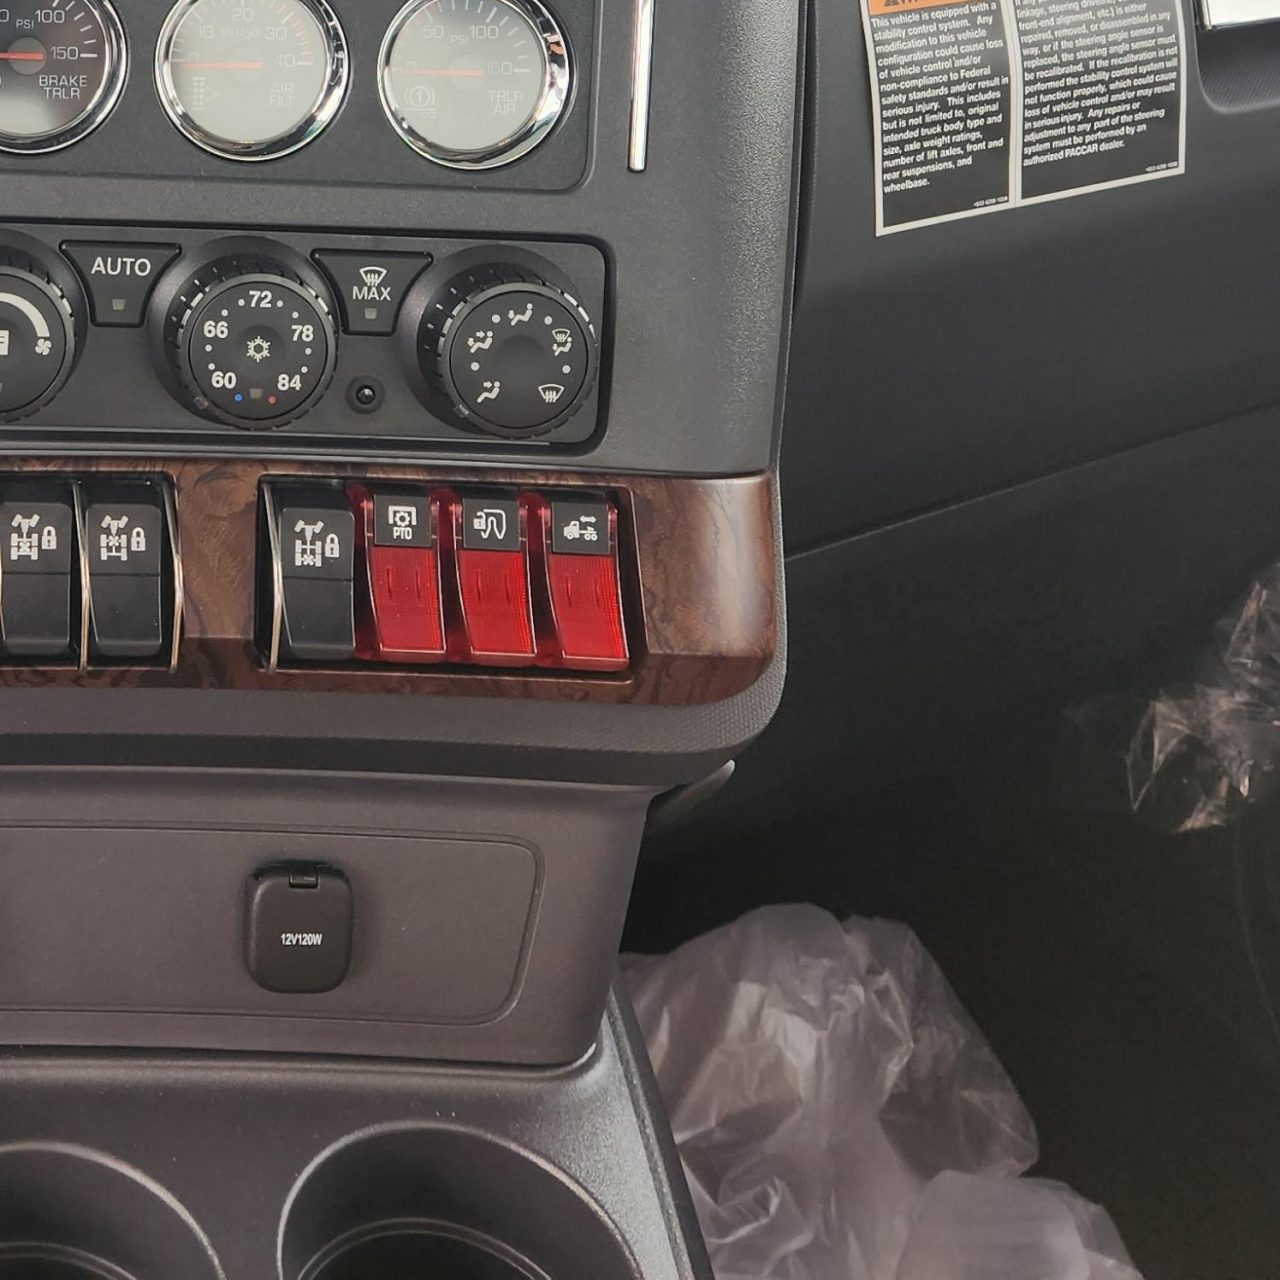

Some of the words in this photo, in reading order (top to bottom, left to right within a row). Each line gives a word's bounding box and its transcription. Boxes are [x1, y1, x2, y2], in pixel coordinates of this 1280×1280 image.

[35, 10, 65, 23] 100
[232, 8, 254, 21] 20
[16, 19, 34, 30] PSI
[470, 25, 499, 39] 100
[874, 28, 905, 41] stability
[908, 23, 936, 35] control
[939, 19, 971, 32] system.
[977, 16, 992, 25] Any
[199, 26, 213, 39] 10
[265, 27, 287, 40] 30
[450, 35, 469, 45] PSI
[876, 38, 927, 53] modification
[929, 36, 937, 45] to
[940, 34, 955, 43] this
[958, 29, 986, 40] vehicle
[50, 47, 79, 60] 150
[878, 50, 933, 66] configuration
[935, 46, 958, 57] could
[960, 42, 984, 52] cause
[986, 39, 1003, 49] loss
[273, 54, 296, 67] 40
[880, 70, 888, 79] of
[891, 65, 920, 77] vehicle
[923, 59, 952, 72] control
[39, 75, 87, 87] BRAKE
[881, 72, 948, 92] non-compliance
[950, 71, 958, 80] to
[960, 66, 991, 79] Federal
[44, 88, 80, 99] TRLR
[271, 83, 293, 93] AIR
[882, 92, 906, 105] safety
[909, 86, 948, 100] standards
[978, 78, 1000, 88] result
[1001, 76, 1008, 85] in
[271, 95, 293, 107] FILT
[488, 90, 524, 103] TRLR
[883, 106, 913, 117] serious
[915, 102, 940, 113] injury.
[947, 97, 964, 106] This
[967, 90, 1001, 103] includes
[495, 103, 516, 114] AIR
[883, 121, 897, 130] but
[899, 119, 906, 128] is
[908, 116, 922, 126] not
[925, 110, 952, 123] limited
[968, 102, 999, 115] original
[884, 129, 919, 142] intended
[921, 124, 941, 136] truck
[944, 121, 964, 132] body
[967, 118, 984, 128] type
[986, 114, 1002, 124] and
[904, 141, 921, 151] axle
[923, 136, 950, 148] weight
[1024, 151, 1063, 166] authorized
[1065, 143, 1098, 157] PACCAR
[884, 172, 900, 180] rear
[957, 156, 972, 167] and
[884, 178, 930, 193] wheelbase.
[91, 257, 151, 276] AUTO
[249, 290, 272, 308] 72
[353, 285, 391, 301] MAX
[203, 320, 229, 339] 66
[292, 325, 314, 342] 78
[211, 371, 237, 389] 60
[277, 374, 301, 391] 84
[393, 527, 412, 540] PTO
[281, 933, 323, 945] 12V120W
